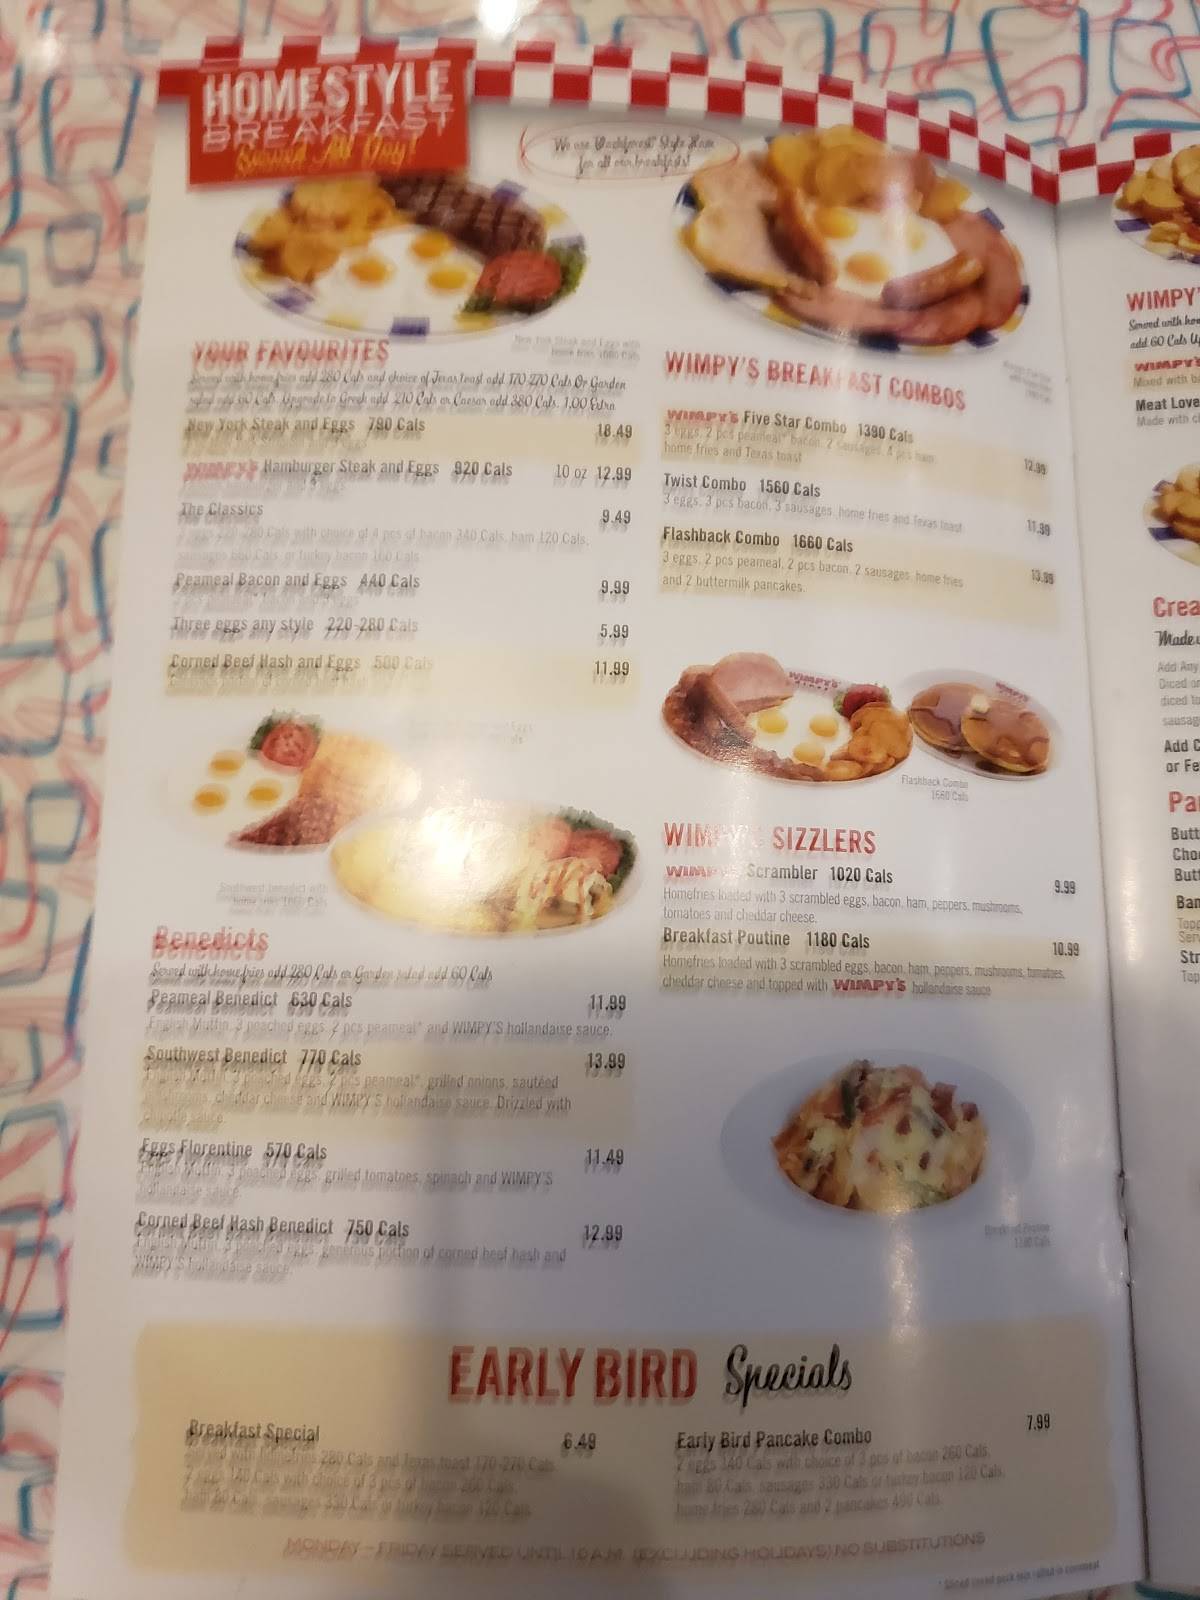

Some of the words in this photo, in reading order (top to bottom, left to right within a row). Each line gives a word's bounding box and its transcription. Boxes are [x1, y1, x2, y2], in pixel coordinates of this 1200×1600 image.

[203, 60, 453, 124] HOMESTYLE
[202, 108, 454, 153] BREAKFAST
[1129, 317, 1160, 332] Served
[1161, 315, 1183, 328] with
[1130, 338, 1147, 349] add
[1150, 335, 1165, 347] 60
[1167, 334, 1188, 348] Cals
[193, 341, 250, 368] YOUR
[256, 338, 391, 367] FAVOURITES
[666, 351, 760, 381] WIMPY'S
[767, 360, 883, 395] BREAKAST
[889, 376, 966, 411] COMBOS
[1133, 376, 1162, 388] Mixed
[1166, 374, 1188, 385] with
[1136, 398, 1168, 412] Meat
[187, 417, 213, 434] New
[217, 417, 248, 433] York
[251, 417, 290, 433] Steak
[294, 417, 318, 432] and
[321, 417, 356, 434] Eggs
[396, 417, 426, 432] Cals
[743, 410, 770, 426] Five
[774, 412, 801, 429] Star
[804, 416, 847, 435] Combo
[858, 423, 886, 440] 1390
[889, 427, 914, 445] Cals
[1137, 415, 1165, 428] Made
[1168, 413, 1190, 425] with
[597, 423, 633, 439] 18.49
[264, 459, 337, 476] Hamburger
[339, 460, 376, 474] Steak
[380, 460, 404, 474] and
[408, 460, 440, 477] Eggs
[454, 461, 480, 477] 920
[483, 461, 513, 477] Cals
[555, 463, 570, 479] 10
[574, 467, 588, 480] oz
[597, 465, 632, 481] 12.99
[664, 473, 698, 489] Twist
[702, 475, 747, 492] Combo
[759, 479, 790, 495] 1560
[793, 482, 821, 498] Cals
[180, 502, 204, 517] The
[207, 502, 264, 517] Classics
[602, 509, 632, 525] 9.49
[663, 526, 731, 544] Flashback
[735, 530, 780, 547] Combo
[792, 534, 823, 550] 1660
[826, 537, 854, 553] Cals
[174, 572, 234, 587] Peameal
[238, 572, 281, 587] Bacon
[285, 572, 310, 587] and
[313, 572, 348, 590] Eggs
[359, 573, 386, 588] 440
[391, 573, 421, 588] Cals
[601, 579, 631, 595] 9.99
[662, 574, 682, 586] and
[686, 575, 693, 586] 2
[696, 576, 750, 589] buttermilk
[753, 579, 805, 593] pancakes.
[172, 616, 211, 631] Three
[215, 619, 248, 634] eggs
[252, 618, 276, 634] any
[280, 616, 315, 634] style
[326, 616, 385, 632] 220-280
[389, 617, 419, 632] Cals
[599, 623, 630, 639] 5.99
[1155, 629, 1194, 646] Made
[170, 653, 220, 668] Corned
[223, 653, 256, 668] Beef
[259, 653, 293, 669] Hash
[298, 654, 323, 669] and
[327, 655, 361, 672] Eggs
[594, 661, 630, 676] 11.99
[1157, 662, 1177, 673] Add
[1180, 660, 1199, 673] Any
[1159, 678, 1187, 689] Diced
[1160, 694, 1188, 707] diced
[1164, 739, 1189, 753] Add
[1166, 761, 1181, 773] or
[901, 774, 941, 787] Flashback
[942, 777, 969, 789] Combo
[772, 826, 876, 854] SIZZLERS
[746, 863, 818, 880] Scrambler
[830, 866, 861, 882] 1020
[866, 867, 893, 884] Cals
[1054, 879, 1076, 895] 9.99
[663, 887, 716, 901] Homefries
[718, 888, 751, 902] loaded
[754, 890, 777, 903] with
[779, 890, 787, 903] 3
[789, 891, 841, 906] scrambled
[843, 894, 870, 909] eggs,
[872, 895, 904, 908] bacon,
[906, 896, 930, 911] ham,
[932, 899, 970, 913] peppers,
[971, 901, 1023, 915] mushrooms,
[663, 907, 711, 920] tomatoes
[714, 908, 733, 921] and
[736, 908, 777, 922] cheddar
[779, 909, 817, 924] cheese.
[152, 926, 269, 957] Benedicts
[663, 926, 733, 944] Breakfast
[737, 928, 791, 946] Poutine
[806, 931, 837, 948] 1180
[841, 932, 870, 949] Cals
[1052, 941, 1080, 957] 10.99
[662, 974, 704, 989] cheddar
[706, 975, 744, 990] cheese
[746, 976, 766, 990] and
[768, 976, 804, 993] topped
[806, 978, 828, 992] with
[832, 978, 907, 993] WIMPY'S
[911, 981, 964, 995] hollandaise
[965, 984, 992, 996] sauce
[149, 989, 212, 1006] Peameal
[214, 990, 278, 1007] Benedict
[290, 991, 317, 1007] 630
[322, 991, 353, 1008] Cals
[589, 994, 627, 1011] 11.99
[146, 1044, 221, 1063] Southwest
[224, 1046, 288, 1064] Benedict
[300, 1048, 326, 1065] 770
[331, 1049, 362, 1066] Cals
[586, 1052, 626, 1069] 13.99
[140, 1137, 175, 1156] Eggs
[179, 1138, 253, 1157] Florentine
[265, 1141, 292, 1158] 570
[296, 1142, 328, 1160] Cals
[586, 1148, 624, 1165] 11.49
[138, 1211, 188, 1229] Corned
[192, 1213, 226, 1230] Beef
[230, 1214, 265, 1231] Hash
[268, 1216, 334, 1234] Benedict
[347, 1218, 374, 1236] 750
[378, 1220, 410, 1237] Cals
[583, 1224, 624, 1241] 12.99
[448, 1345, 585, 1401] EARLY
[594, 1347, 699, 1402] BIRD
[724, 1343, 853, 1407] Specials
[186, 1419, 262, 1439] Breakfast
[264, 1422, 320, 1443] Special
[1026, 1413, 1051, 1431] 7.99
[562, 1432, 597, 1450] 6.49
[676, 1431, 716, 1453] Early
[720, 1431, 751, 1449] Bird
[755, 1429, 819, 1449] Pancake
[823, 1427, 872, 1446] Combo
[863, 1531, 987, 1555] SUBSTITUTIONS
